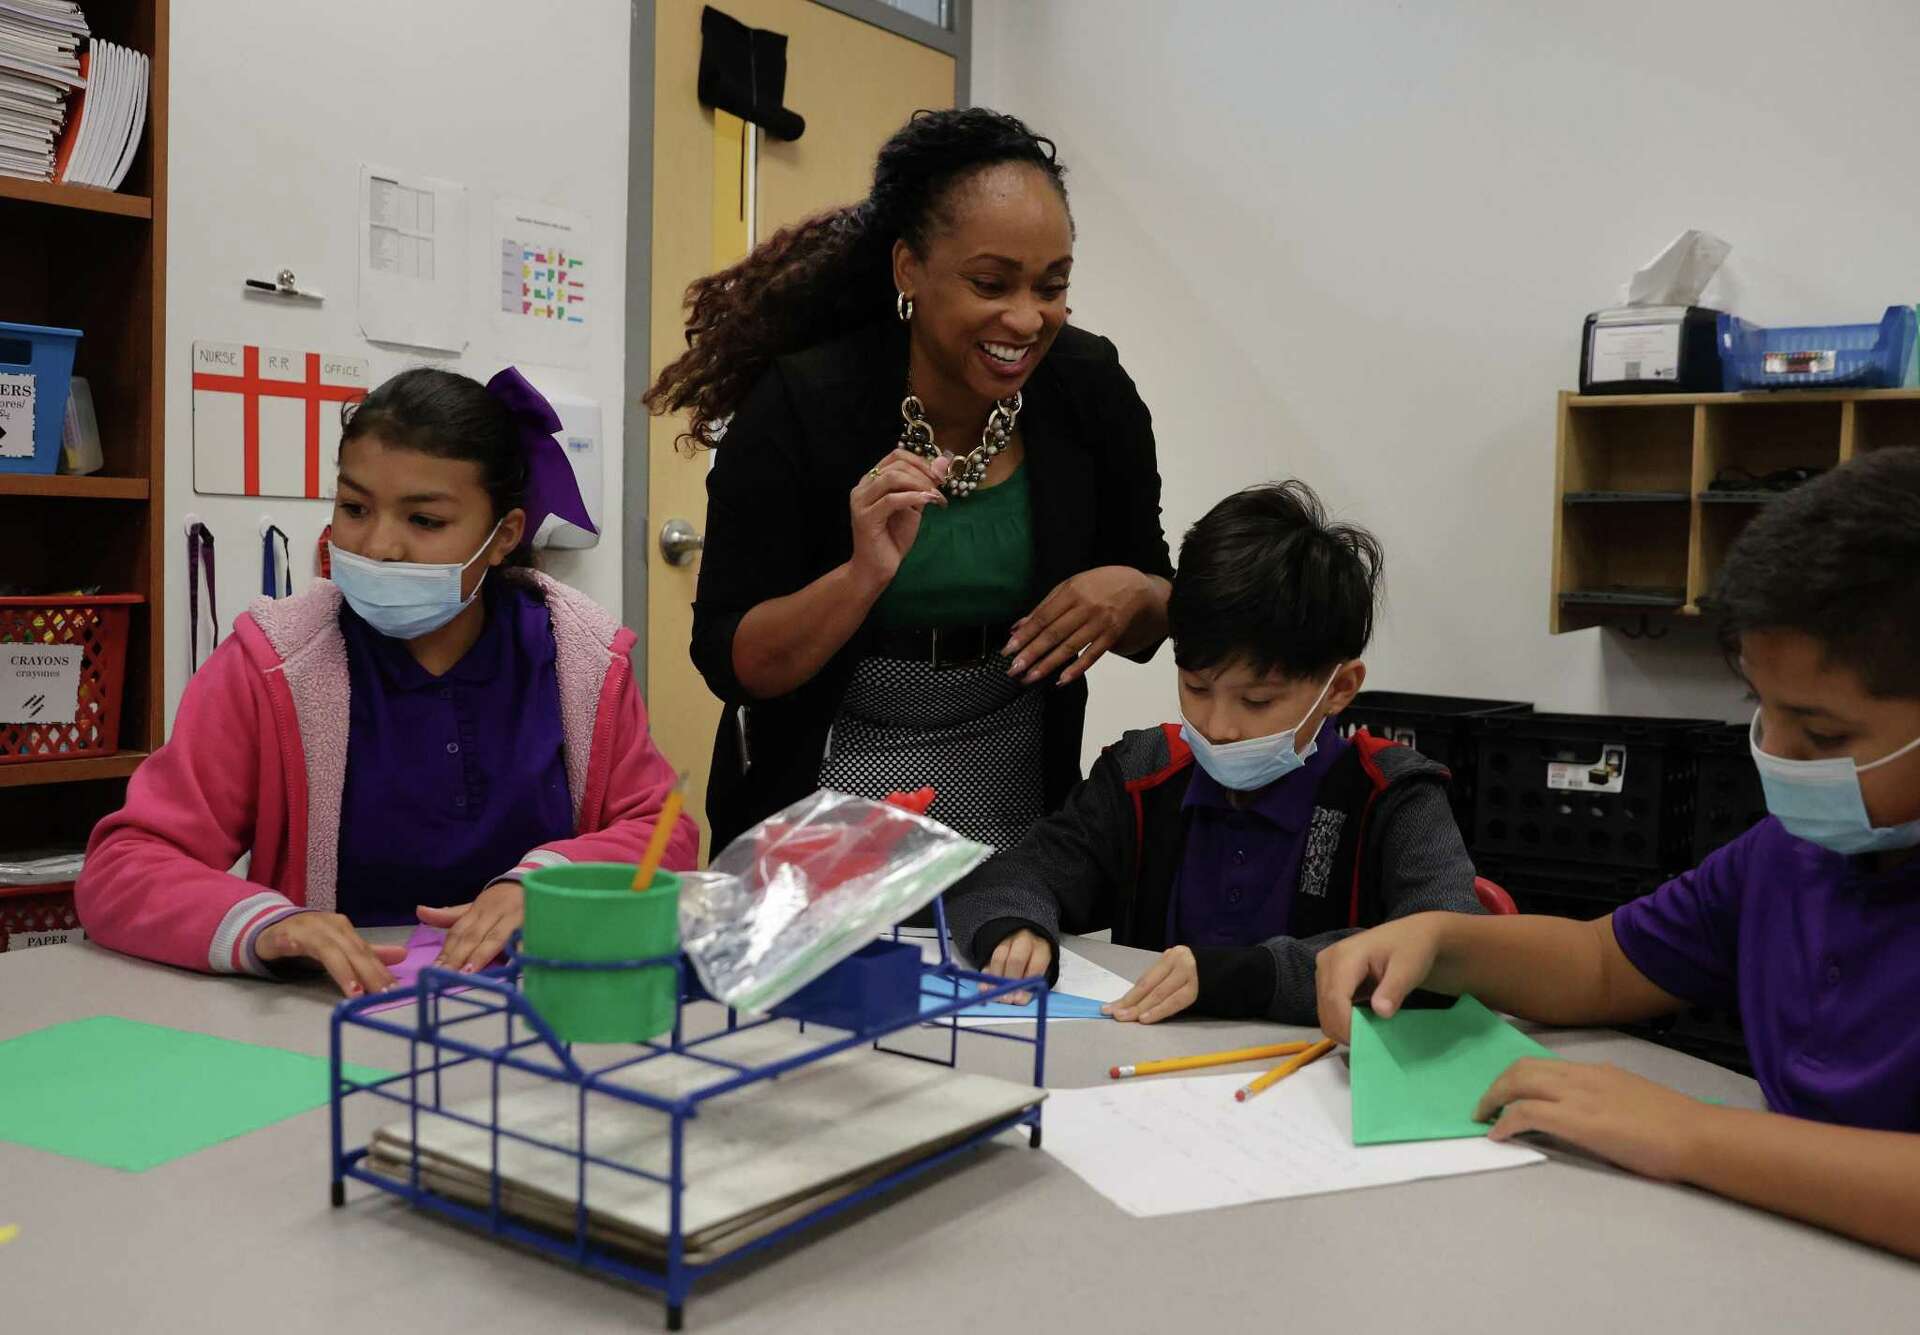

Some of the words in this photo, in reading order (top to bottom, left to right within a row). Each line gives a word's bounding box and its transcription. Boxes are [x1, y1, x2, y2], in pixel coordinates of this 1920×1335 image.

[200, 350, 237, 366] NURSE
[324, 363, 360, 377] OFFICE
[10, 655, 70, 667] CRAYONS
[27, 935, 68, 947] PAPER
